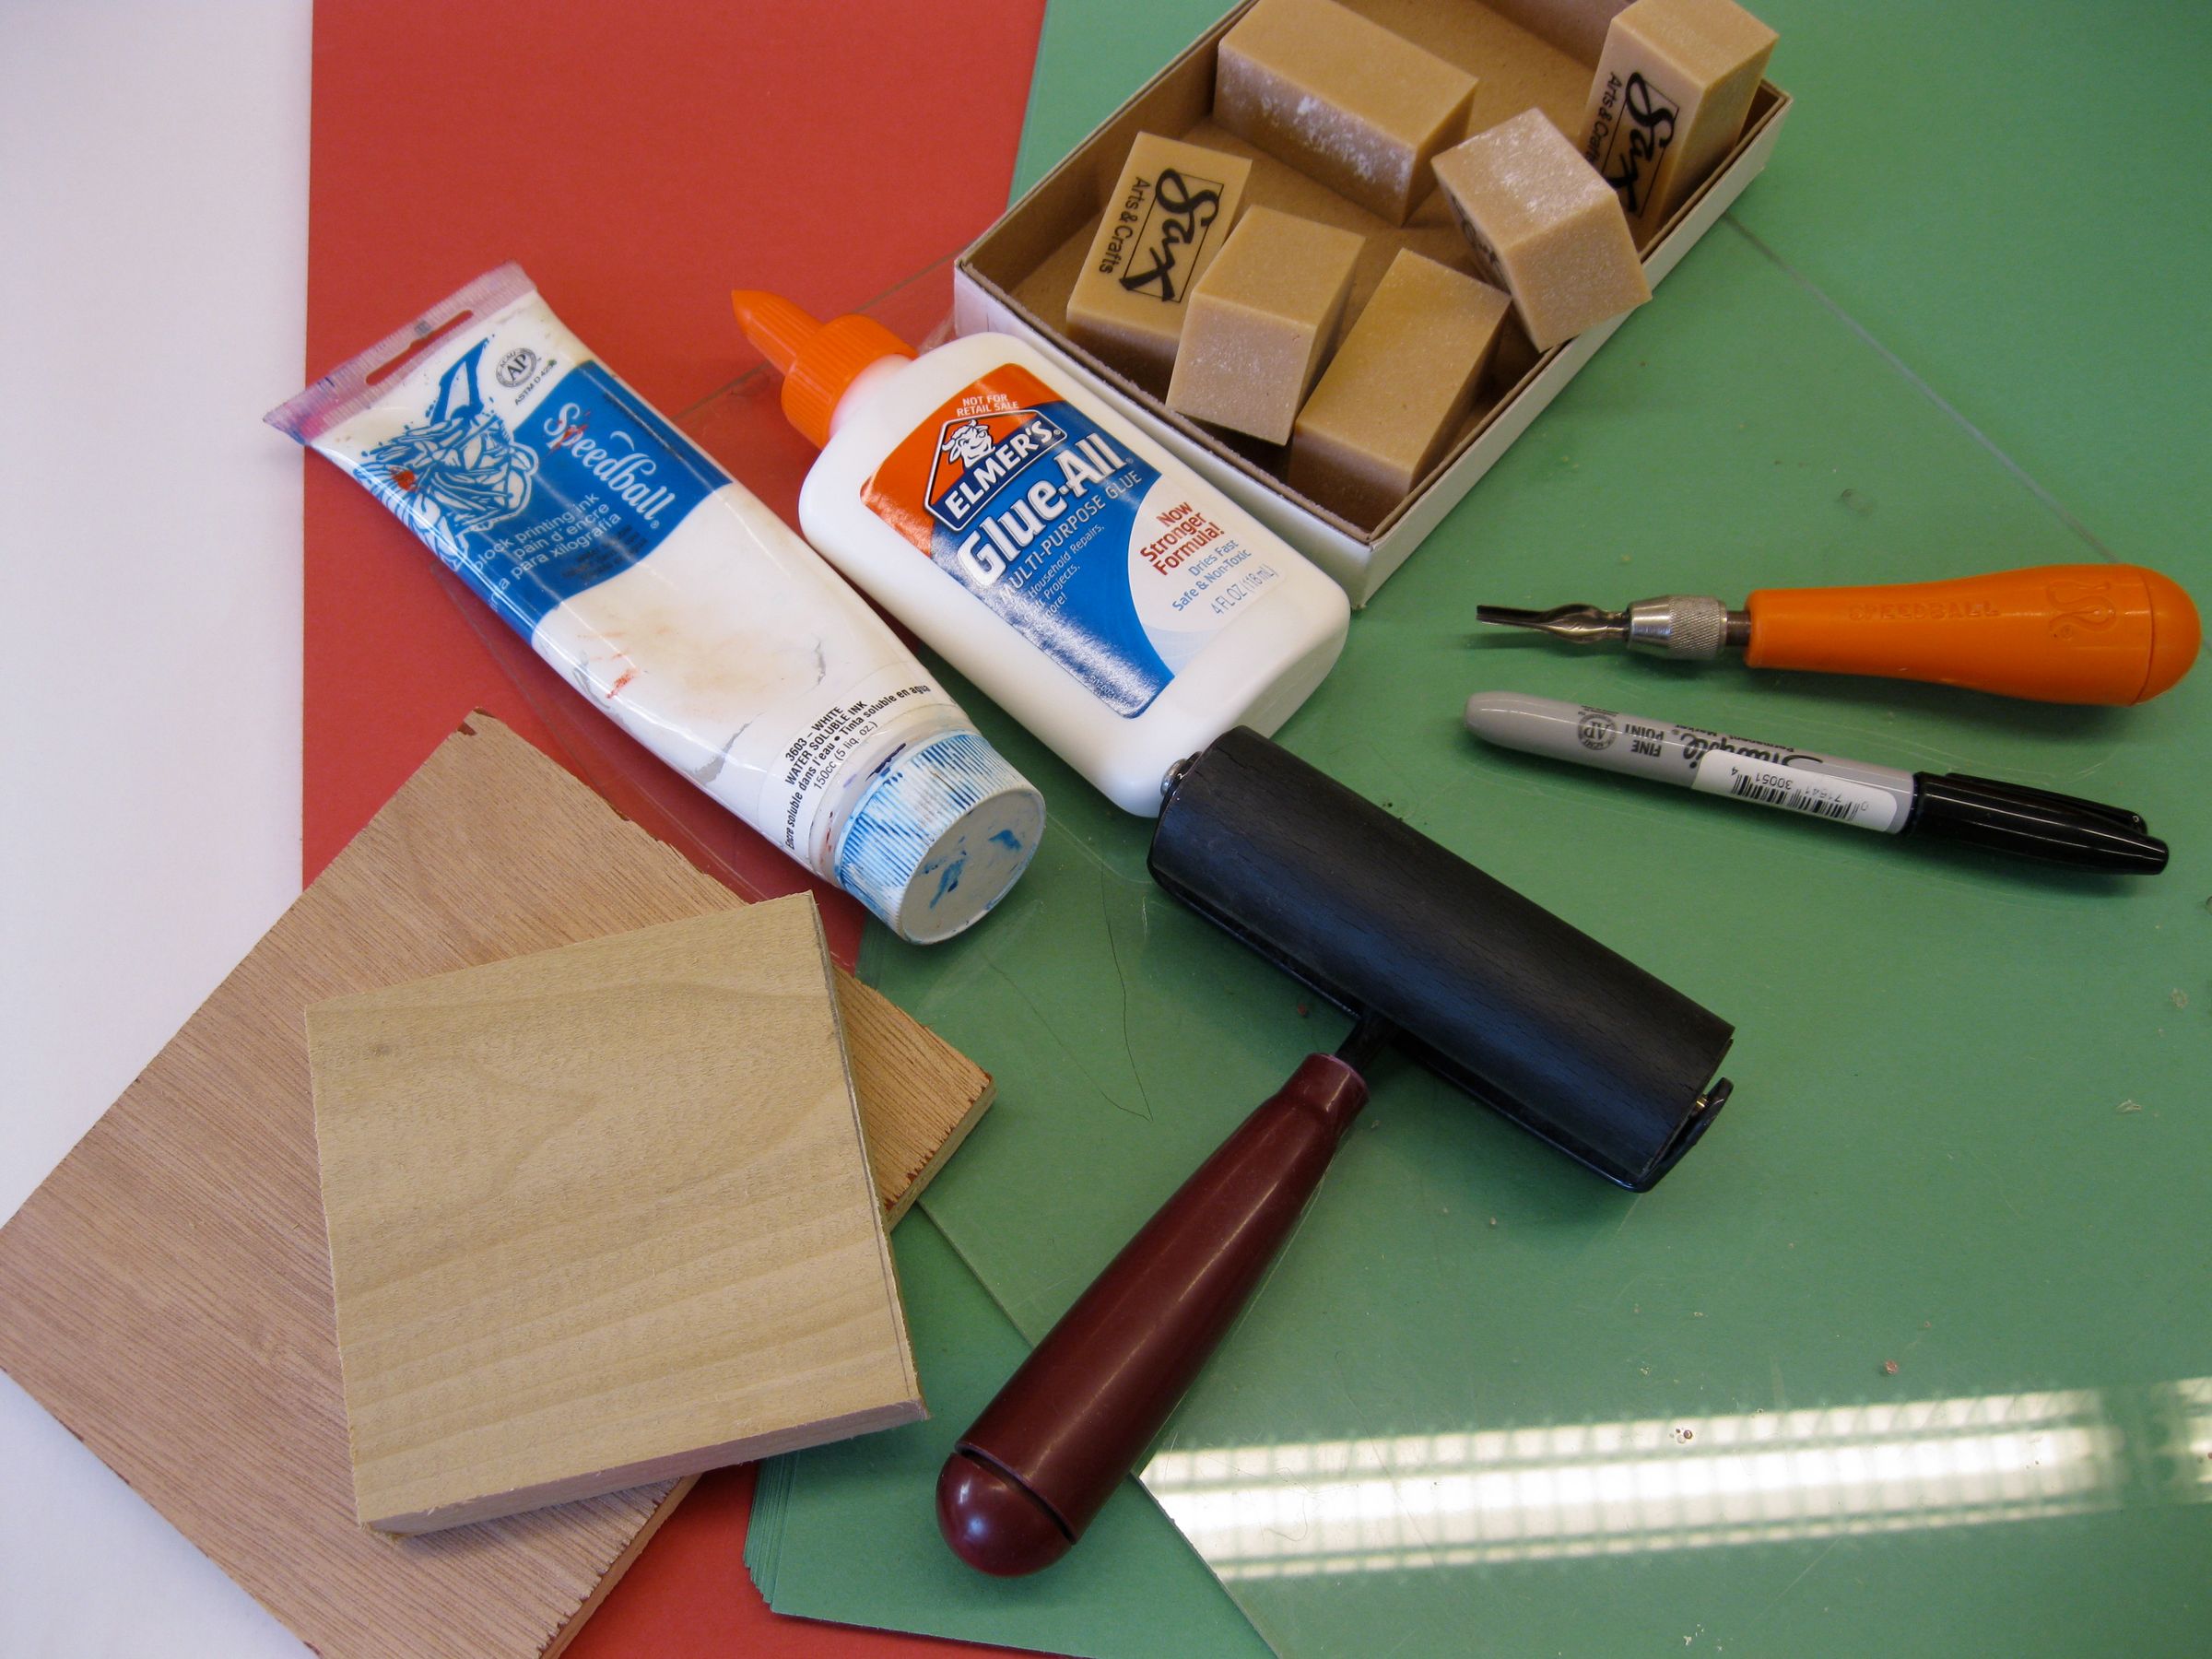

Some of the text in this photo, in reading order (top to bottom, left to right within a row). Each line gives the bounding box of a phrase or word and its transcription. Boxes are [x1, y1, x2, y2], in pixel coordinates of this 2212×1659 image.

[1584, 72, 1622, 162] Arts & Craft
[1606, 72, 1676, 213] Sax
[1099, 176, 1151, 275] Arts & Crafts
[1118, 168, 1220, 302] Sax
[507, 353, 527, 382] AP
[514, 382, 535, 406] ASTM
[533, 376, 541, 384] D
[956, 401, 1020, 418] RETAIL SALE
[962, 394, 1008, 407] NOT FOR
[544, 402, 677, 521] Speedball
[944, 420, 1053, 520] ELMER'S
[513, 510, 576, 544] printing
[571, 492, 600, 514] ink
[957, 432, 1126, 586] Glue-All
[1156, 501, 1194, 527] Now
[510, 553, 549, 581] para
[551, 512, 622, 558] xilografía
[512, 537, 549, 560] pain
[997, 469, 1143, 604] MULTI-PURPOSE GLUE
[1028, 549, 1073, 599] Household
[1069, 523, 1106, 555] Repairs,
[1139, 512, 1207, 563] Stronger
[1152, 522, 1225, 576] Formula!
[1187, 538, 1240, 577] Dries Fast
[1043, 563, 1082, 600] Projects,
[1171, 548, 1253, 612] Safe & Non-Toxic
[1215, 596, 1236, 611] FL
[1226, 582, 1248, 601] OZ
[1240, 572, 1263, 594] (118
[1210, 602, 1224, 615] 4
[1847, 600, 2000, 622] SPEEDBALL
[784, 737, 807, 762] 3603
[811, 706, 844, 732] WHITE
[784, 700, 868, 786] WATER SOLUBLE INK
[813, 721, 878, 791] 150cc (5 liq. oz.)
[1583, 721, 1611, 740] AP
[1624, 723, 1665, 758] FINE POINT
[784, 684, 932, 851] Encre soluble dans l'eau Tinta soluble en agua
[1730, 766, 1739, 777] 4
[1755, 771, 1794, 791] 30051
